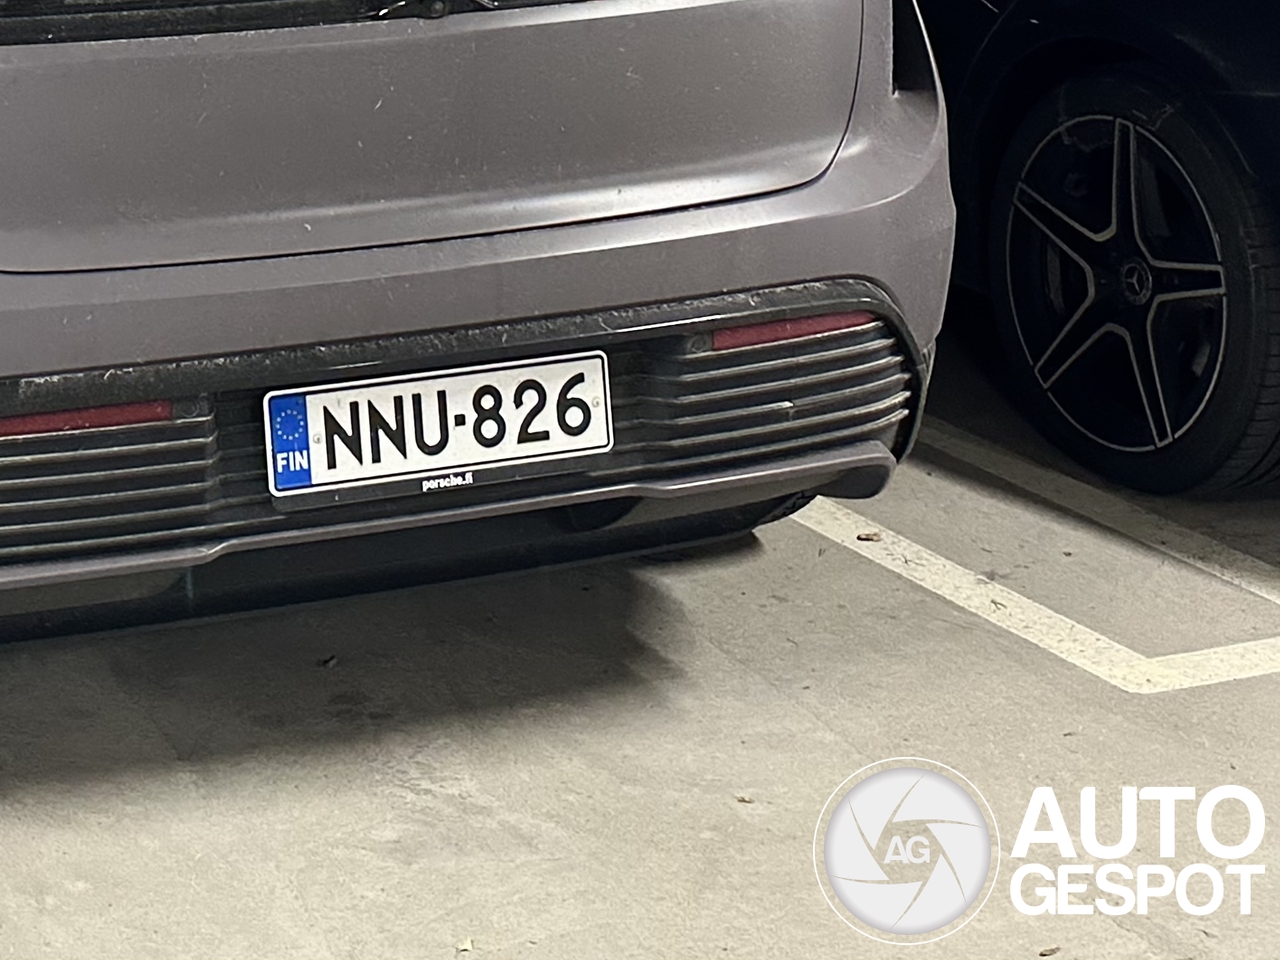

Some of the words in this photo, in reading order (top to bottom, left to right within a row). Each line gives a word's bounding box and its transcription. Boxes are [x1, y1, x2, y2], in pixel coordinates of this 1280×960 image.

[322, 372, 592, 470] NNU-826
[276, 450, 309, 473] FIN
[422, 471, 474, 492] porsche.fi
